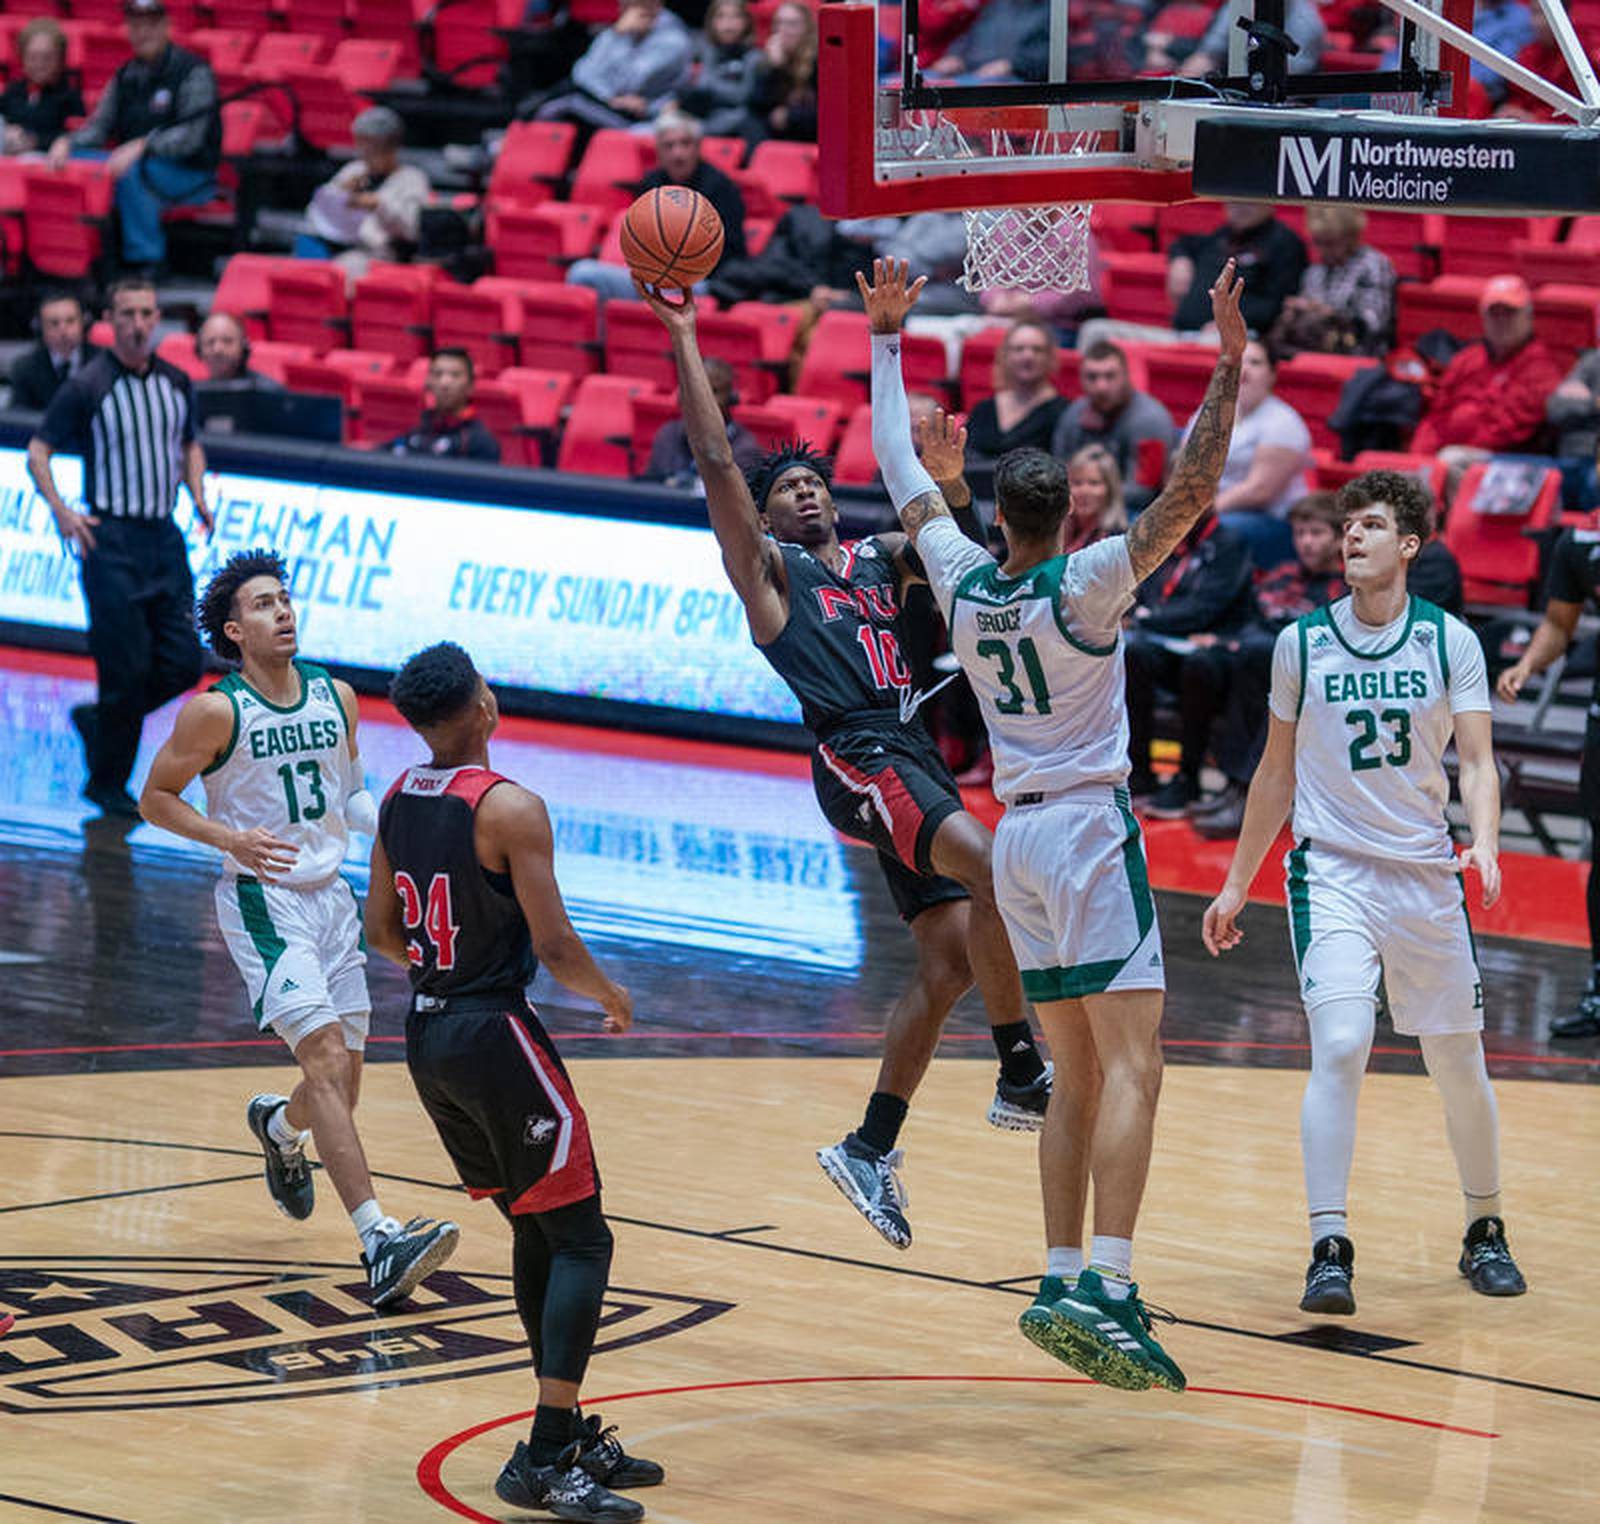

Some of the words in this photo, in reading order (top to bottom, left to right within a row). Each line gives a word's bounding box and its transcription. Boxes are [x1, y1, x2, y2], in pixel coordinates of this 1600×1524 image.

[1350, 137, 1515, 169] Northwestern
[1348, 171, 1448, 200] Medicine
[448, 560, 548, 619] EVERY
[548, 574, 673, 634] SUNDAY
[673, 587, 744, 643] 8PM
[976, 636, 1053, 715] 31
[1324, 669, 1428, 703] EAGLES
[249, 719, 338, 760] EAGLES
[1345, 708, 1412, 772] 23
[277, 759, 326, 824] 13
[394, 870, 461, 971] 24
[268, 1333, 445, 1371] 1946
